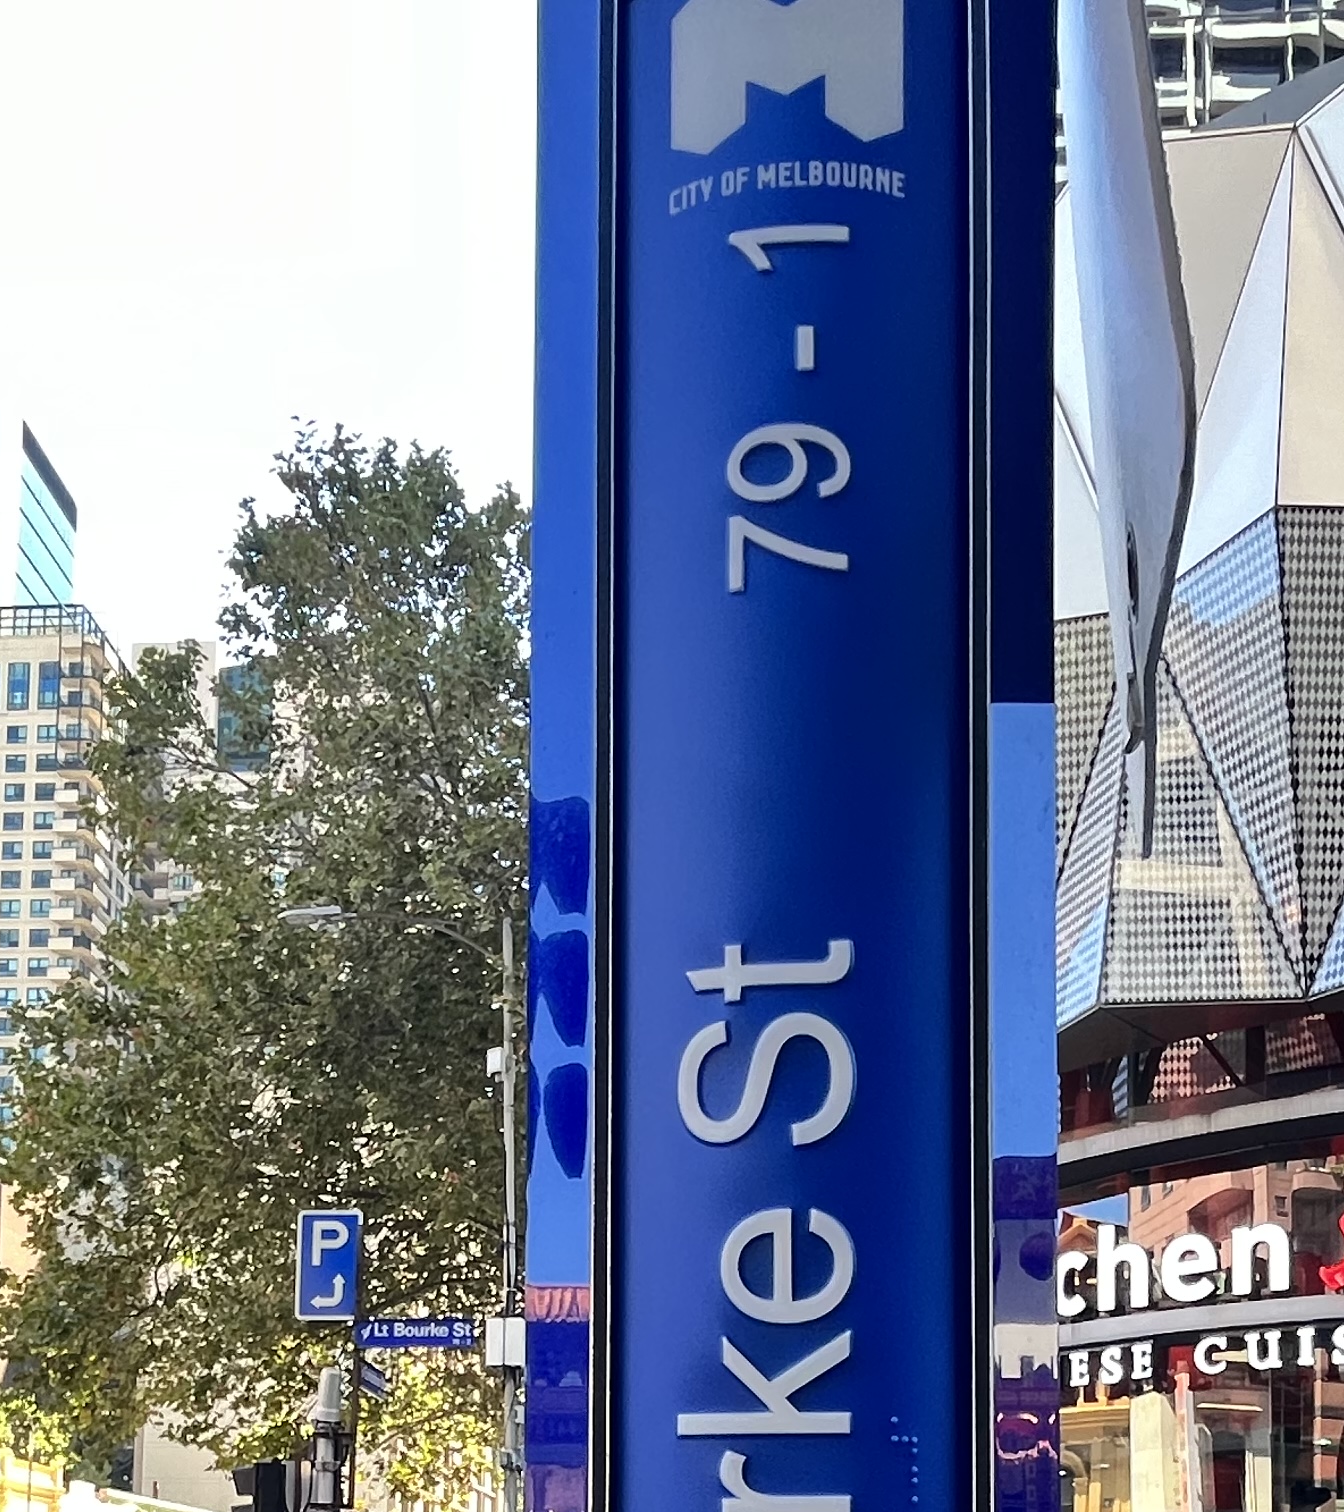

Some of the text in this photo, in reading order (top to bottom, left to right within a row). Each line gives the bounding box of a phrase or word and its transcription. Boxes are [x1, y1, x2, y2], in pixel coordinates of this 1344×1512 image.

[669, 160, 906, 216] CITY OF MELBOURNE
[728, 223, 850, 273] 1
[726, 421, 851, 594] 79
[676, 938, 856, 1147] St
[311, 1220, 350, 1267] P
[1057, 1221, 1291, 1318] chen
[373, 1321, 473, 1338] Lt Bourke St
[1069, 1341, 1155, 1389] ESE
